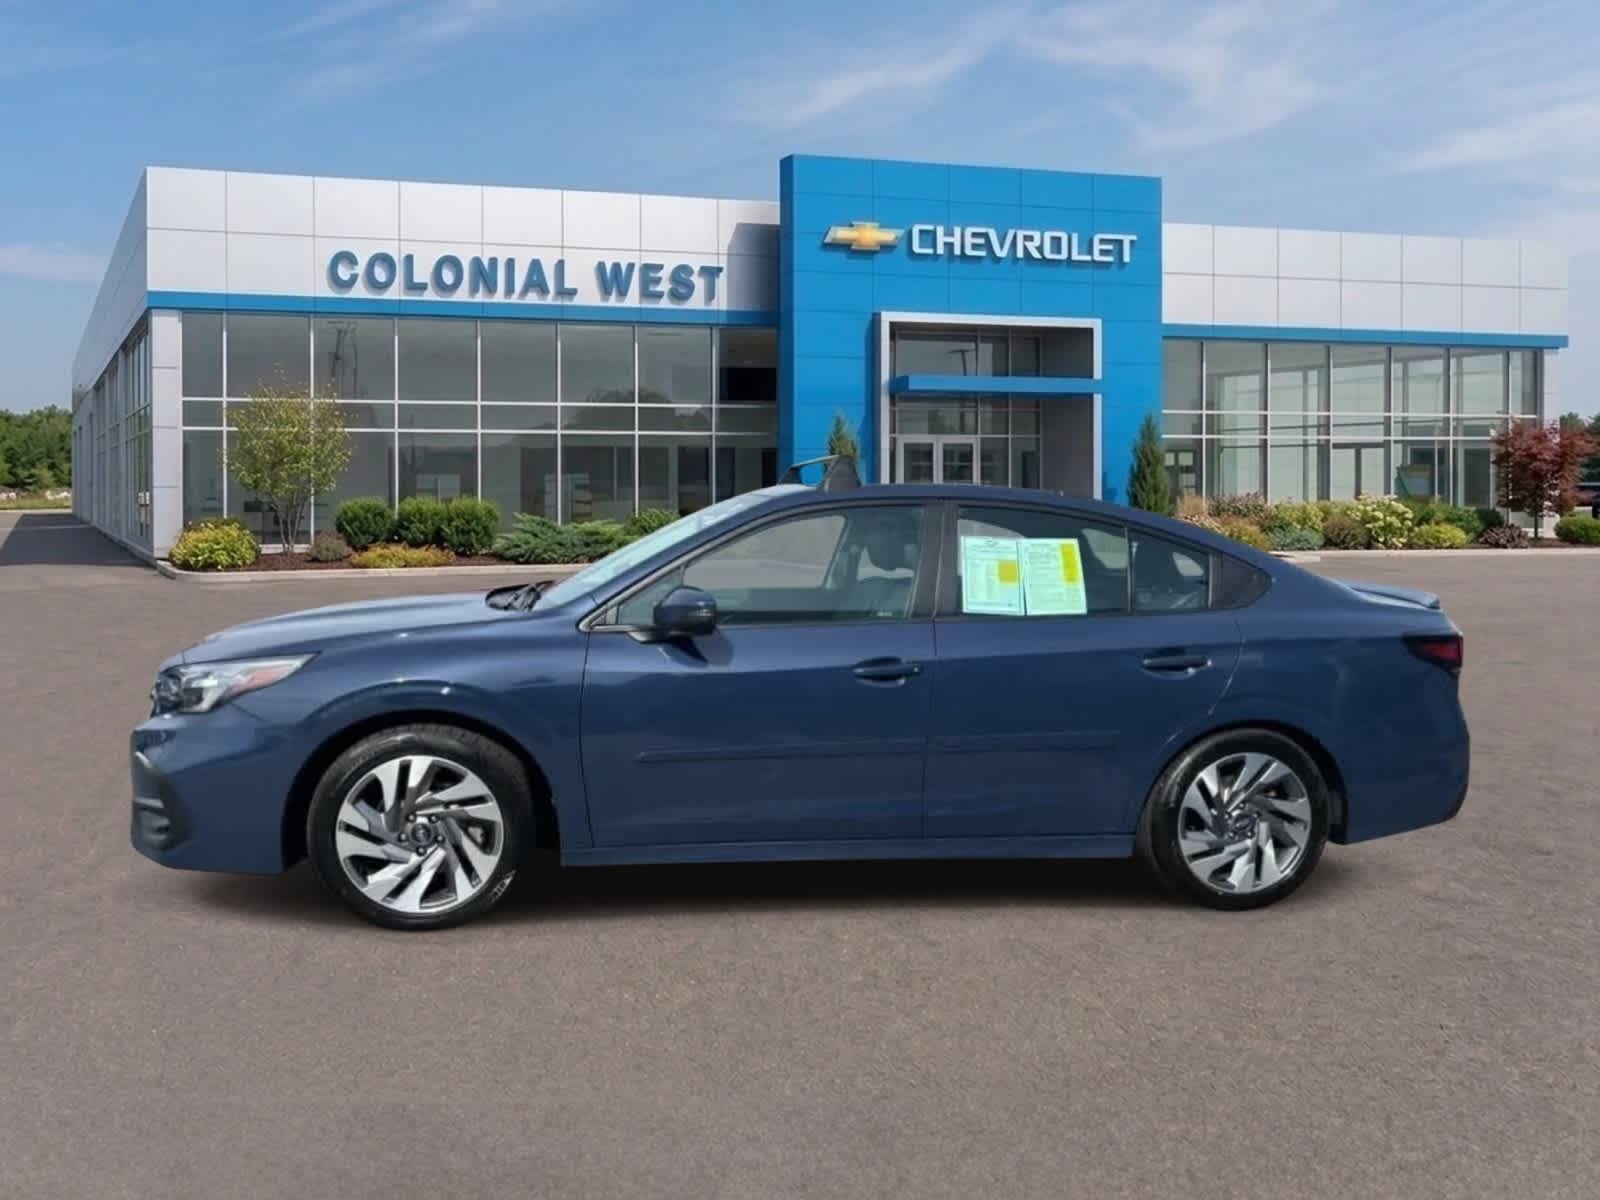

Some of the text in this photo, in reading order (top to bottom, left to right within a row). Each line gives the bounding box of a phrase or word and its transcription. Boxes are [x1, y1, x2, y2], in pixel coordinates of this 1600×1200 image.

[911, 223, 1137, 263] CHEVROLET
[328, 250, 724, 302] COLONIAL WEST
